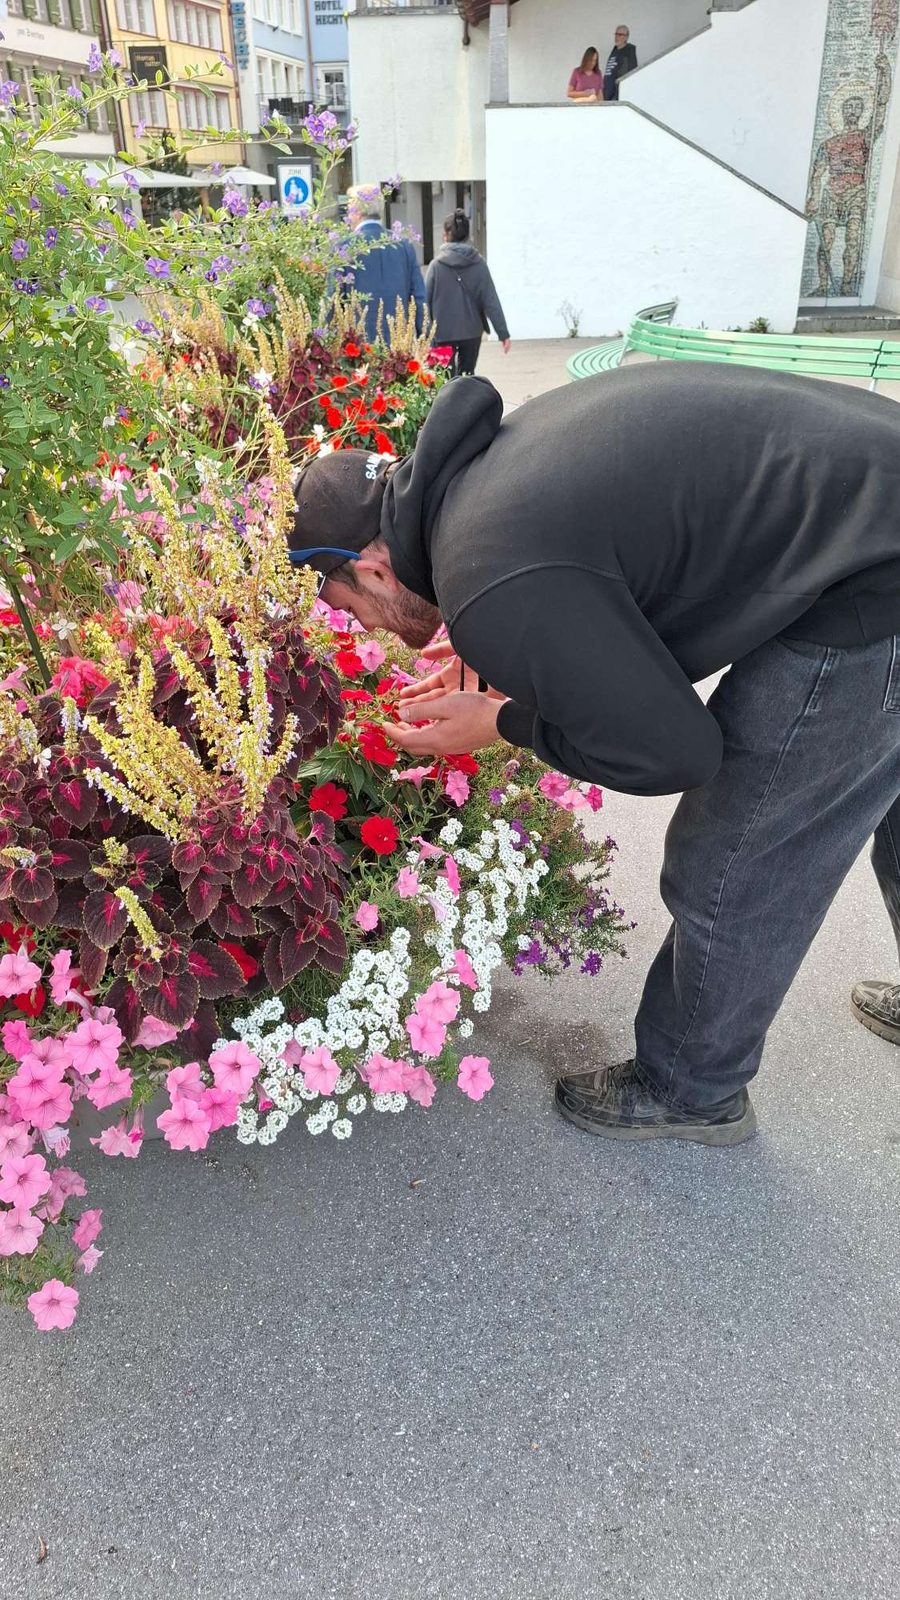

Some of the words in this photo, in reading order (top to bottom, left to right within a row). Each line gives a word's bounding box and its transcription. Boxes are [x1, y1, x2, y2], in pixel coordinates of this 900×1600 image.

[315, 0, 343, 11] HOTEL
[315, 14, 344, 25] HECHT
[231, 2, 249, 70] HECHT
